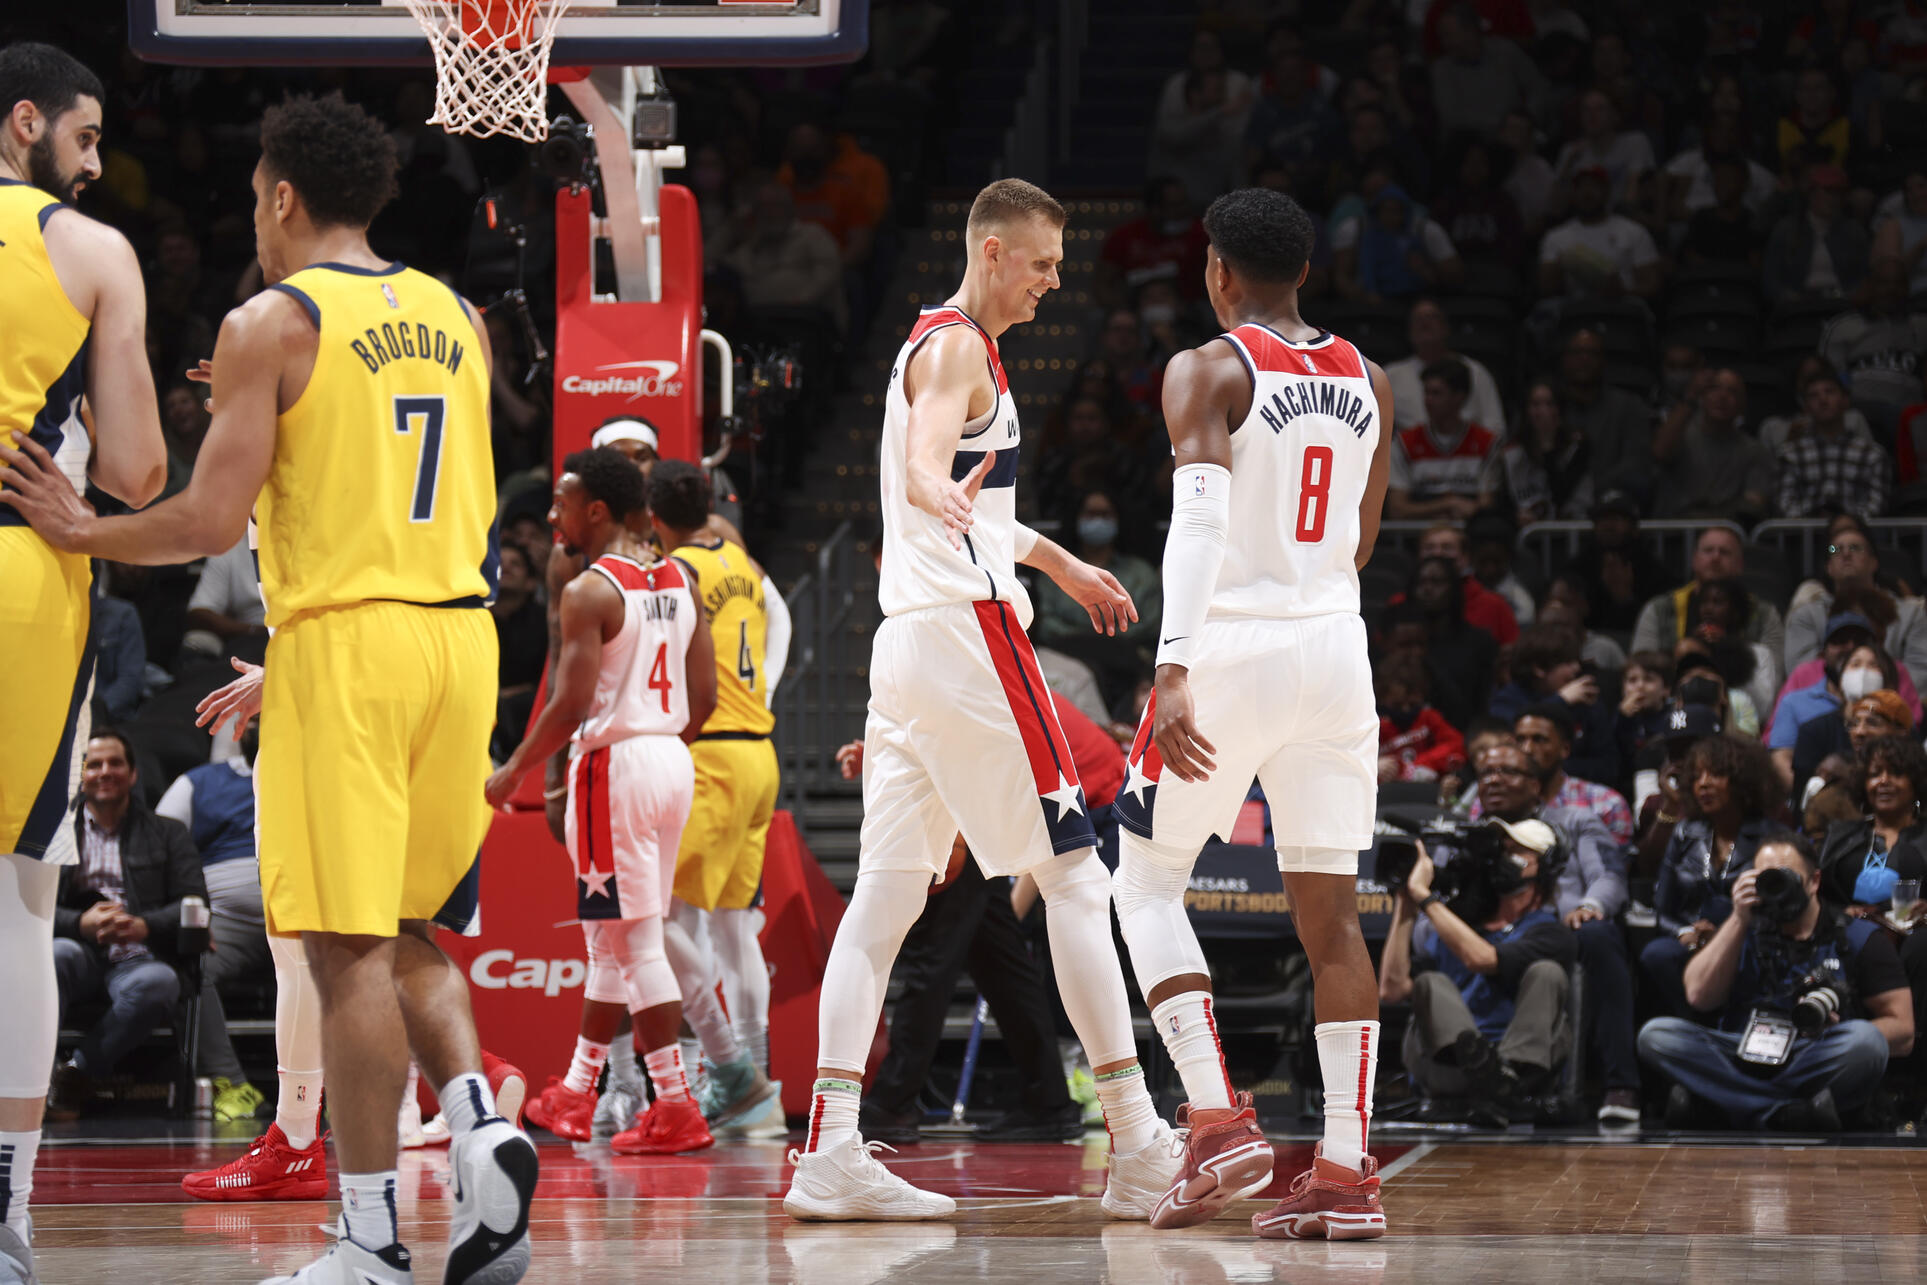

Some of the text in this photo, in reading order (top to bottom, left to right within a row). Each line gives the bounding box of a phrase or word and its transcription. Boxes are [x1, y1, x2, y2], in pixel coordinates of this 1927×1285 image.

[350, 321, 464, 376] BROGDON
[1259, 382, 1374, 439] HACHIMURA
[392, 394, 446, 523] 7
[1295, 445, 1333, 543] 8
[648, 641, 673, 714] 4
[737, 619, 756, 692] 4
[1183, 889, 1290, 913] PORTSBOO
[1186, 876, 1248, 893] AESARS
[469, 949, 586, 997] Cap
